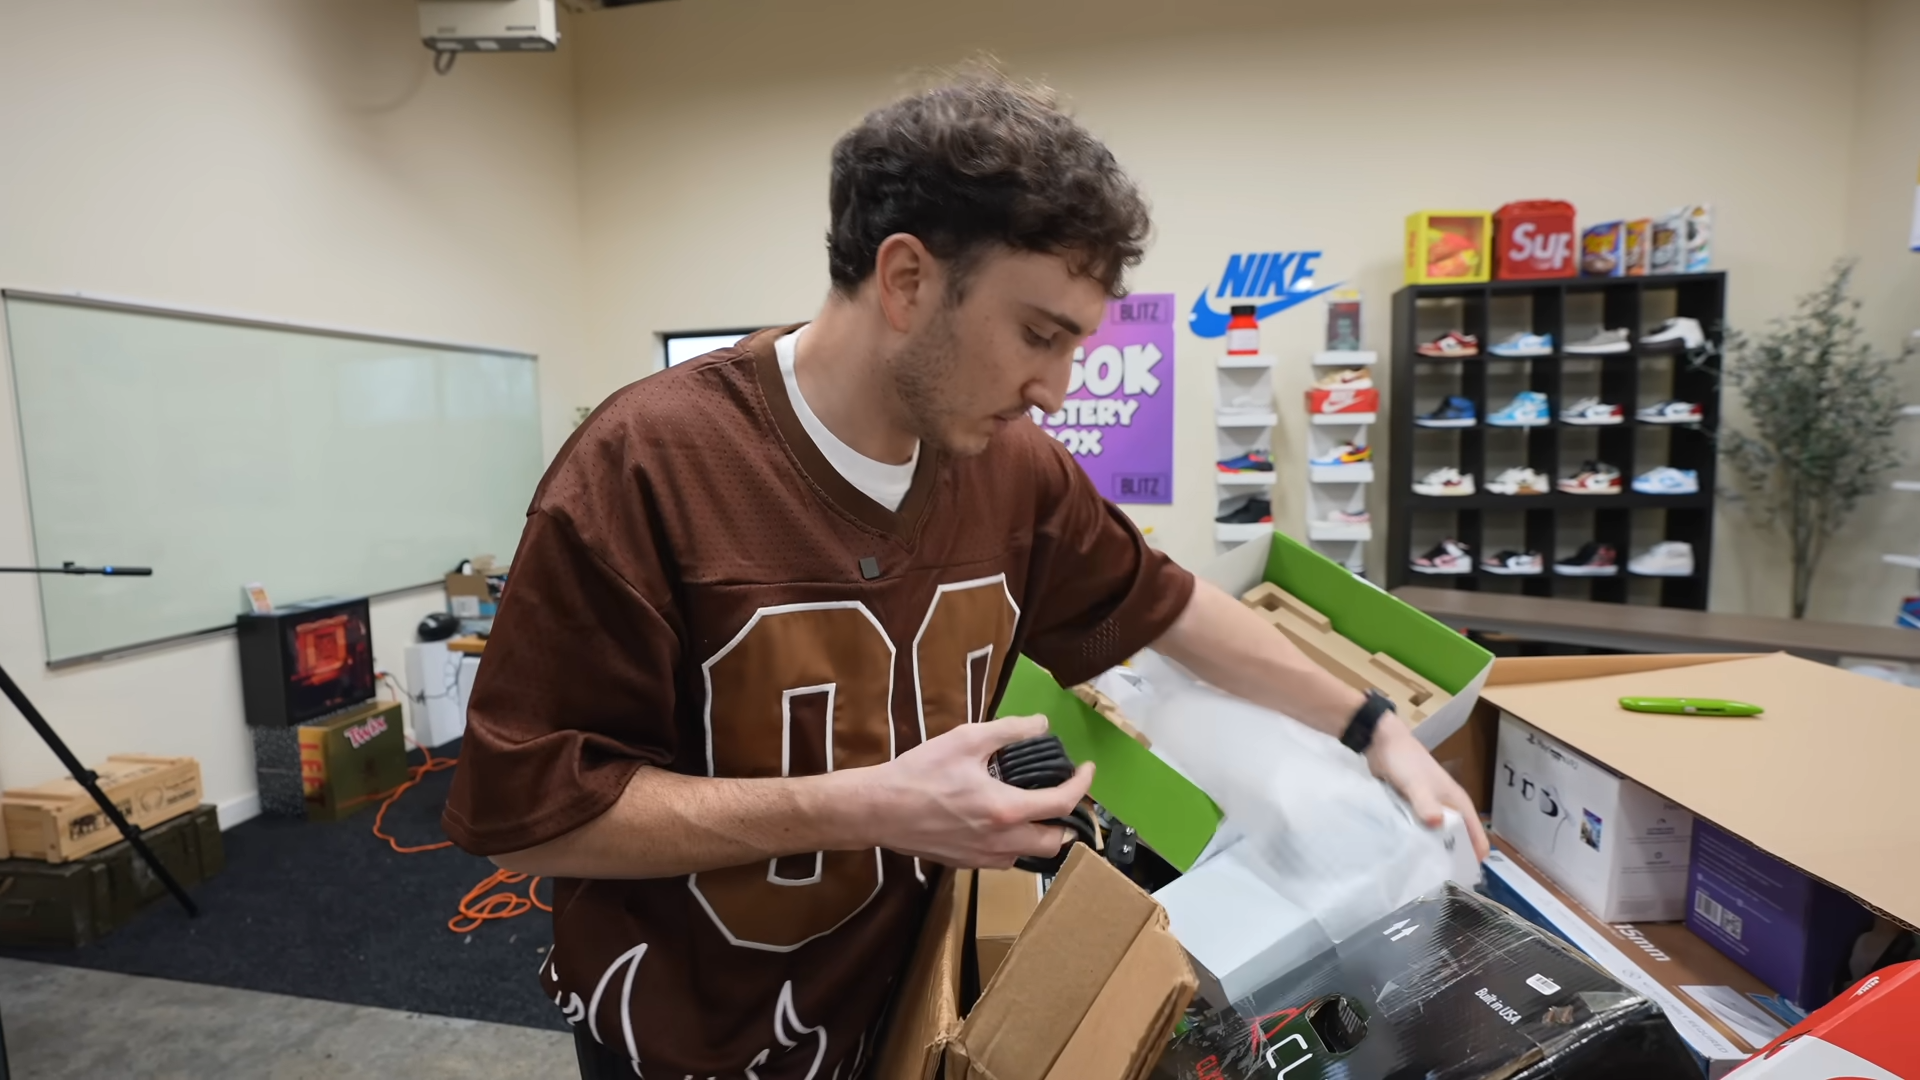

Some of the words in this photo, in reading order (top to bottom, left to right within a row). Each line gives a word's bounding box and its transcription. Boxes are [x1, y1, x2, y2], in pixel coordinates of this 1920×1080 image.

[1215, 251, 1323, 299] NIKE
[1119, 303, 1160, 321] BLITZ
[1025, 398, 1140, 428] YSTERY
[1045, 428, 1102, 456] OX
[1120, 478, 1160, 496] BLITZ
[1613, 923, 1671, 961] 15mm
[1474, 987, 1498, 1005] Built
[1489, 1000, 1504, 1012] in
[1498, 1006, 1522, 1025] USA
